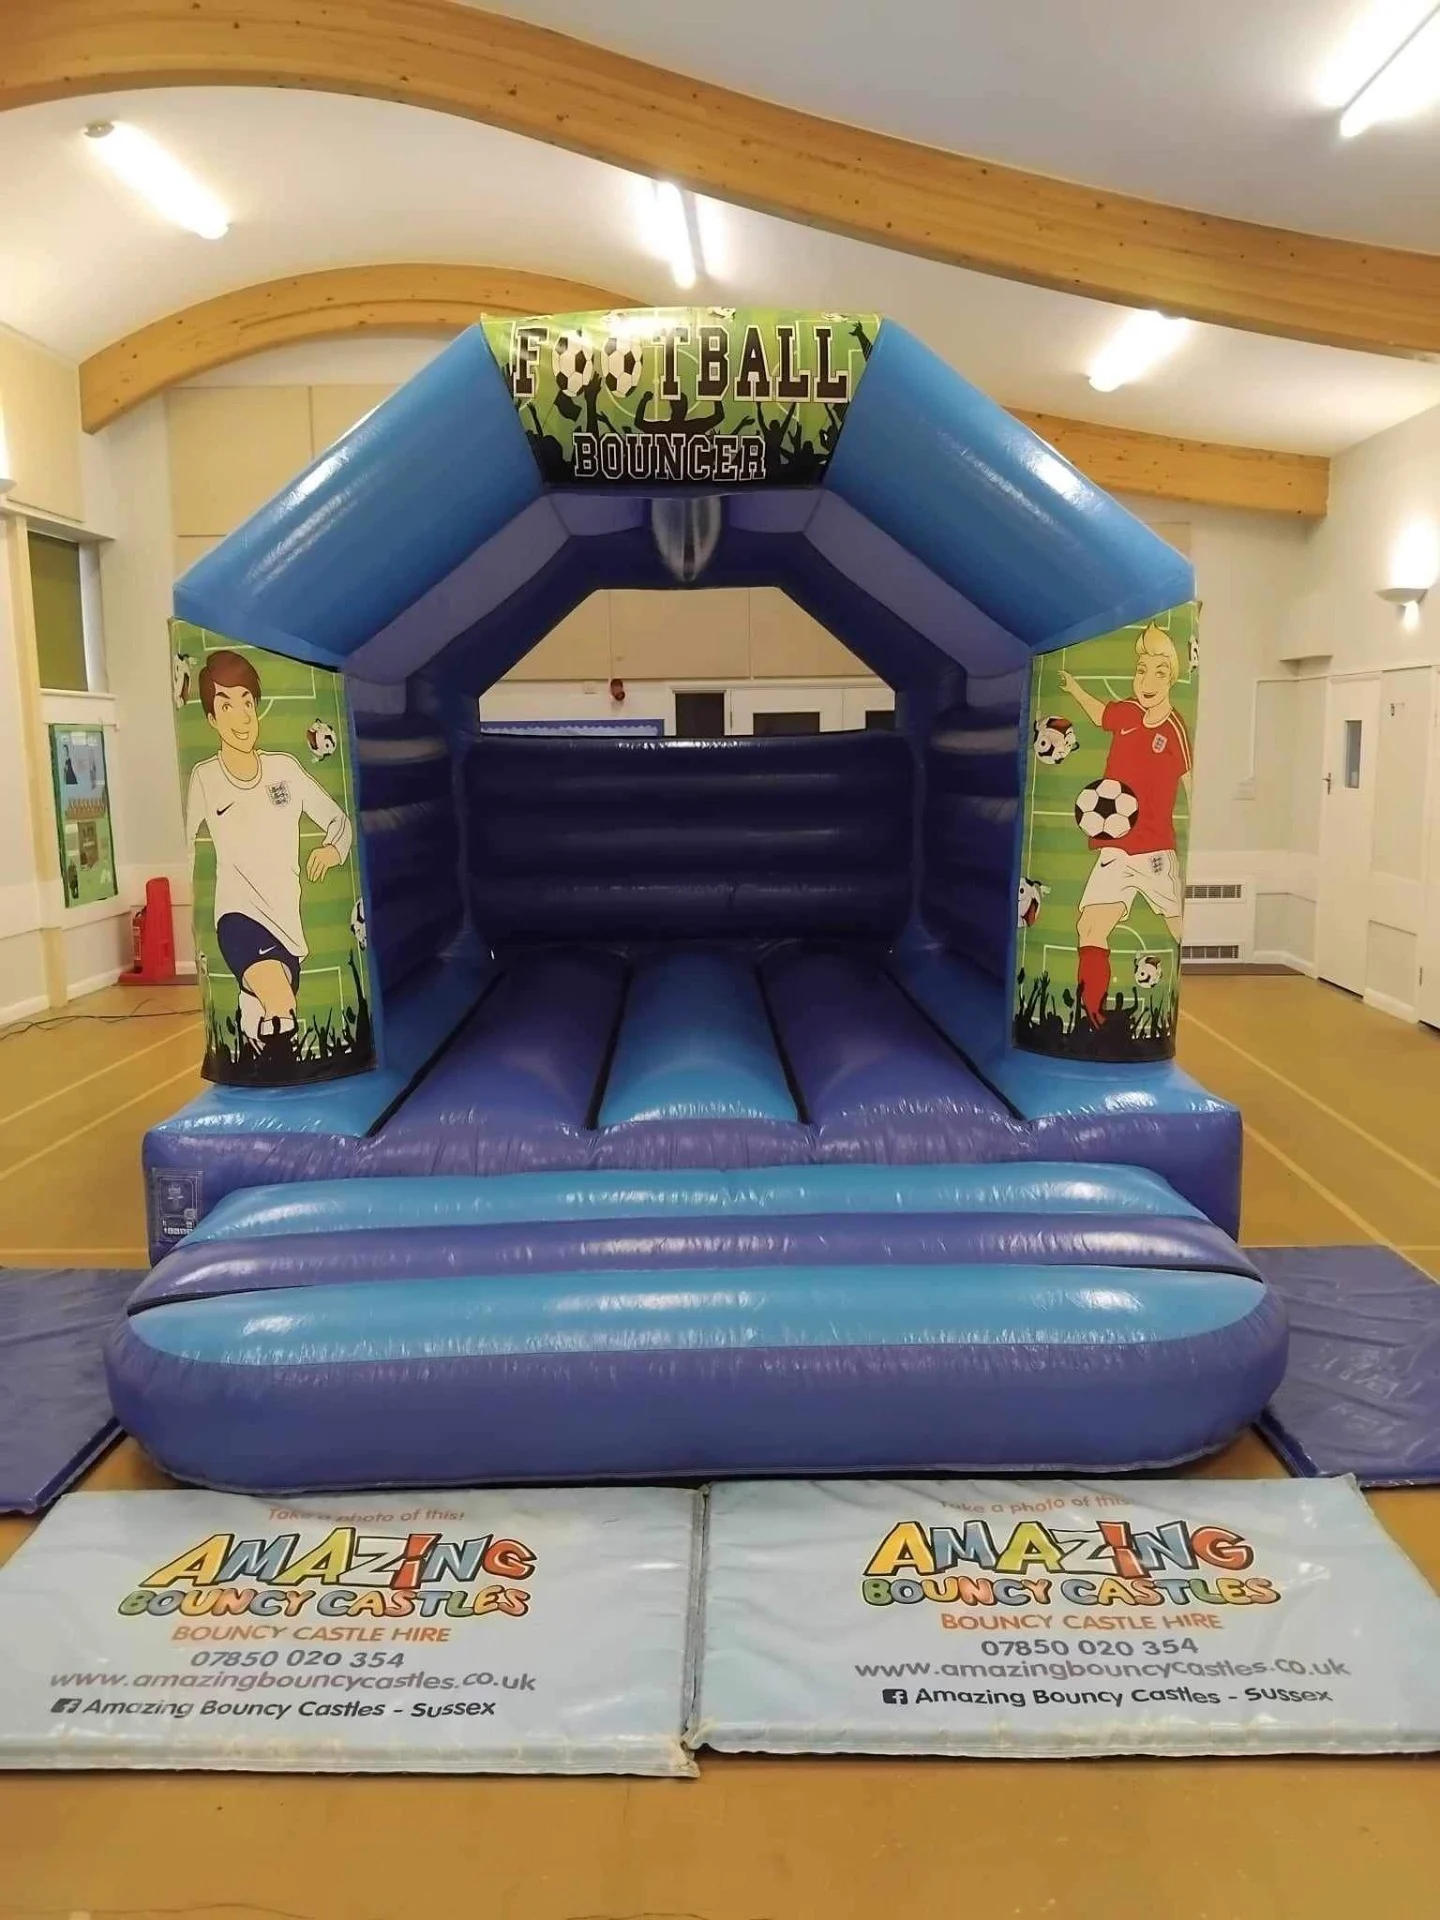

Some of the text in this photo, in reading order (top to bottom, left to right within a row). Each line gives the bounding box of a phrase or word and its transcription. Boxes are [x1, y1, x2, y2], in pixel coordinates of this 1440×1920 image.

[510, 322, 852, 403] FOOTBALL
[572, 432, 767, 481] BOUNCER
[400, 1507, 421, 1521] of
[425, 1508, 465, 1521] this!
[991, 1503, 1004, 1513] a
[1010, 1498, 1065, 1515] photo
[1071, 1496, 1090, 1507] of
[138, 1526, 537, 1590] AMAZING
[863, 1520, 1254, 1579] AMAZING
[118, 1585, 531, 1617] BOUNCY CASTLES
[862, 1576, 1281, 1606] BOUNCY CASTLES
[941, 1613, 1223, 1630] BOUNCY CASTLE HIRE
[171, 1625, 452, 1642] BOUNCY CASTLE HIRE
[981, 1637, 1199, 1656] 07850 020 354
[190, 1649, 405, 1668] 07850 020 354
[854, 1658, 1351, 1680] www.amazingbouncycastles.co.uk
[50, 1671, 537, 1691] www.amazingbouncycastles.co.uk
[915, 1688, 1026, 1707] Amazing
[1033, 1689, 1123, 1707] Bouncy
[1131, 1686, 1221, 1704] Castles
[1244, 1687, 1334, 1702] Sussex
[82, 1698, 194, 1718] Amazing
[199, 1700, 291, 1719] Bouncy
[298, 1701, 386, 1717] Castles
[410, 1702, 496, 1718] Sussex
